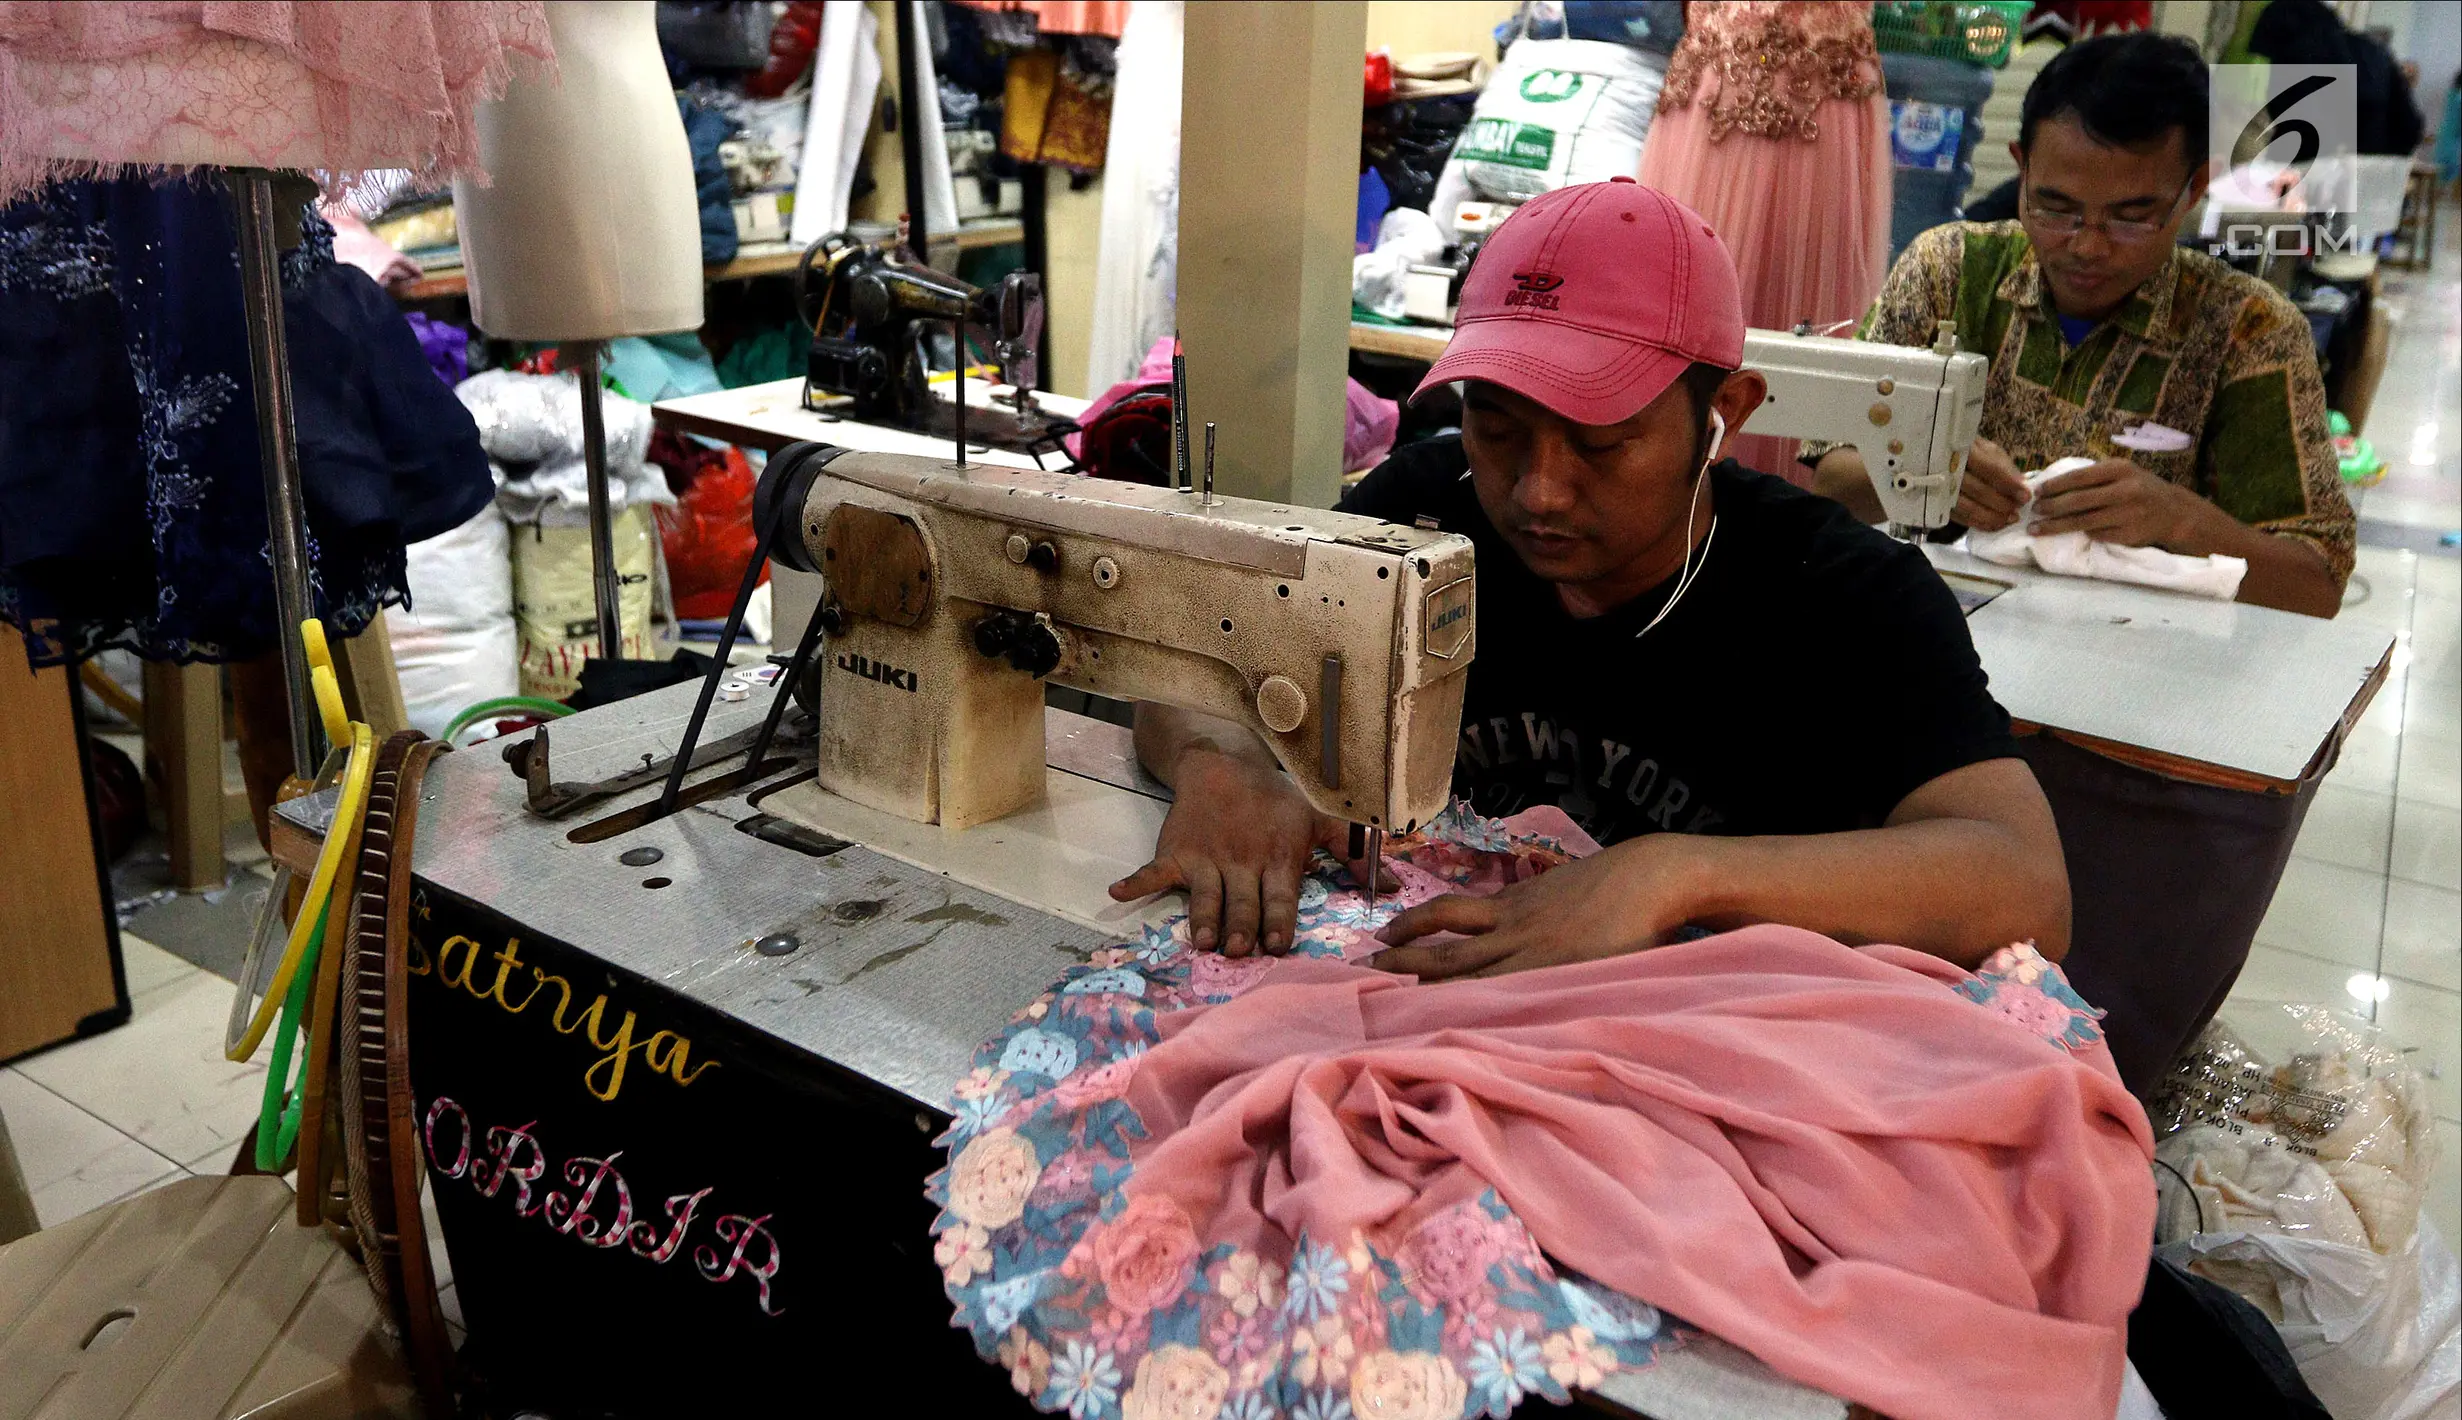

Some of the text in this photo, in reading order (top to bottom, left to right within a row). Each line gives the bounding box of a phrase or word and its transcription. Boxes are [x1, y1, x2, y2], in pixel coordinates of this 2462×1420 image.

[1504, 290, 1560, 311] DIESEL
[1431, 603, 1467, 632] JUKI
[837, 653, 918, 692] JUKI
[1459, 711, 1559, 775] NEW
[2285, 1143, 2318, 1157] BLOK
[410, 1087, 786, 1317] ORDIR
